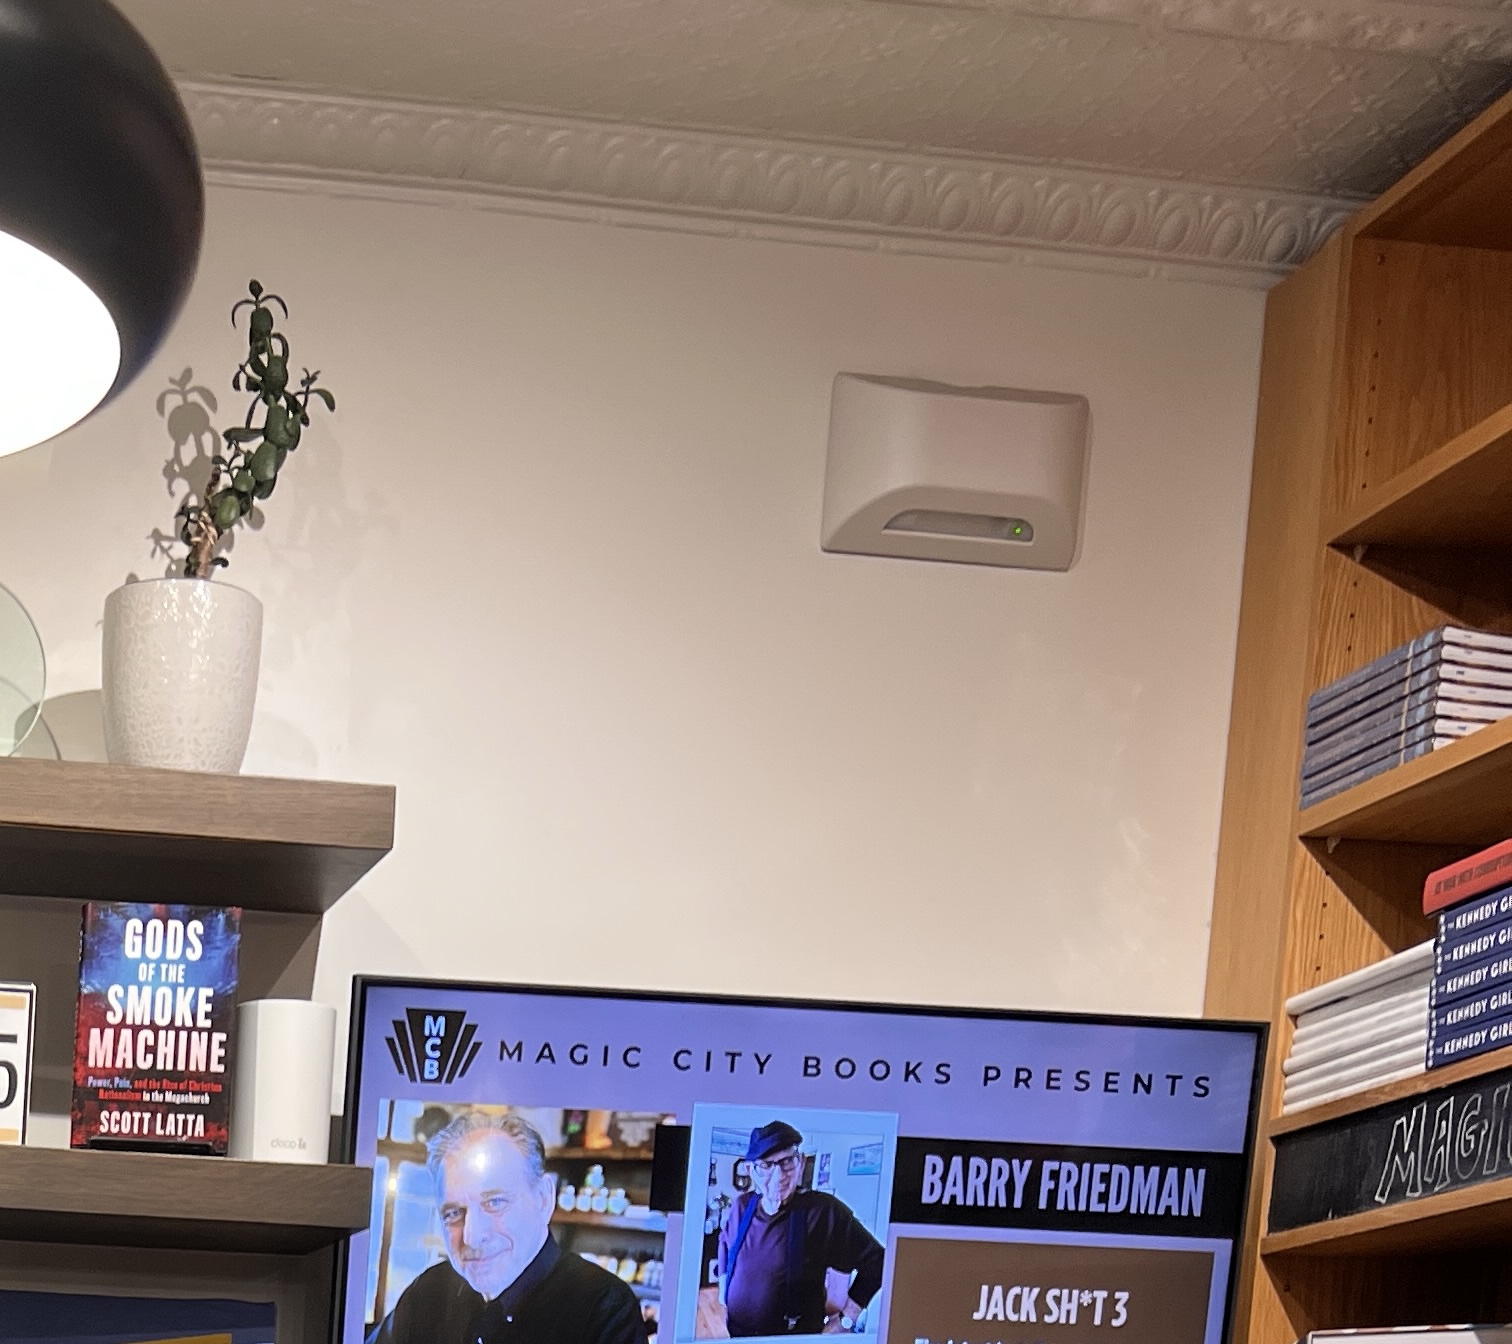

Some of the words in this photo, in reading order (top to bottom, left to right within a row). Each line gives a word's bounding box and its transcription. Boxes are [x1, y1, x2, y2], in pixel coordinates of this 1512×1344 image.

[124, 918, 204, 961] GODS
[138, 962, 155, 982] OF
[160, 963, 186, 983] THE
[1445, 964, 1490, 995] KENNEDY
[106, 984, 214, 1028] SMOKE
[1445, 996, 1489, 1026] KENNEDY
[88, 1027, 227, 1073] MACHINE
[498, 1038, 642, 1069] MAGIC
[673, 1049, 774, 1076] CITY
[803, 1056, 952, 1085] BOOKS
[983, 1065, 1211, 1098] PRESENTS
[100, 1110, 152, 1133] SCOTT
[156, 1113, 205, 1138] LATTA
[921, 1154, 1033, 1209] BARRY
[1038, 1159, 1206, 1217] FRIEDMAN
[972, 1285, 1040, 1322] JACK
[1111, 1291, 1130, 1327] 3
